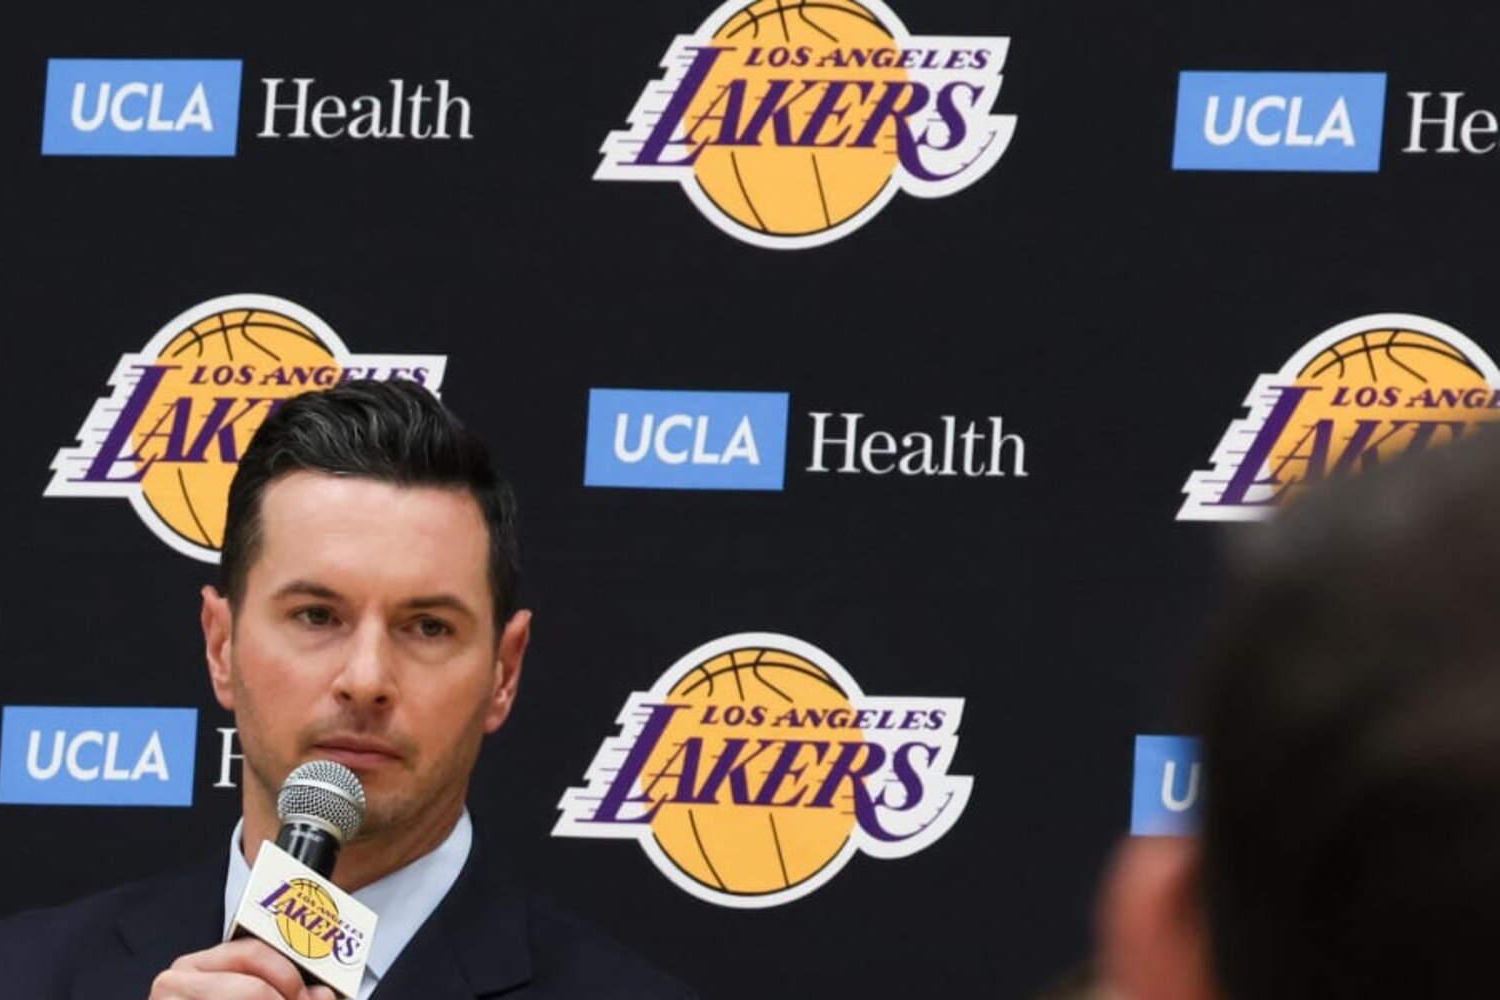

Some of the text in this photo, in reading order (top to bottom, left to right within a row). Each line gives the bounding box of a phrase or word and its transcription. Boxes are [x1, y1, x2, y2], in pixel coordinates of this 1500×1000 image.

[744, 46, 990, 70] LOS ANGELES
[70, 78, 473, 139] UCLA Health
[617, 46, 998, 183] LAKERS
[1203, 95, 1356, 147] UCLA
[189, 365, 256, 386] LOS
[1330, 386, 1401, 408] LOS
[66, 364, 298, 483] LAK
[613, 412, 1028, 477] UCLA Health
[1199, 386, 1485, 507] LAK
[700, 705, 946, 731] LOS ANGELES
[26, 730, 169, 781] UCLA
[573, 703, 954, 844] LAKERS
[259, 881, 361, 966] LAKERS
